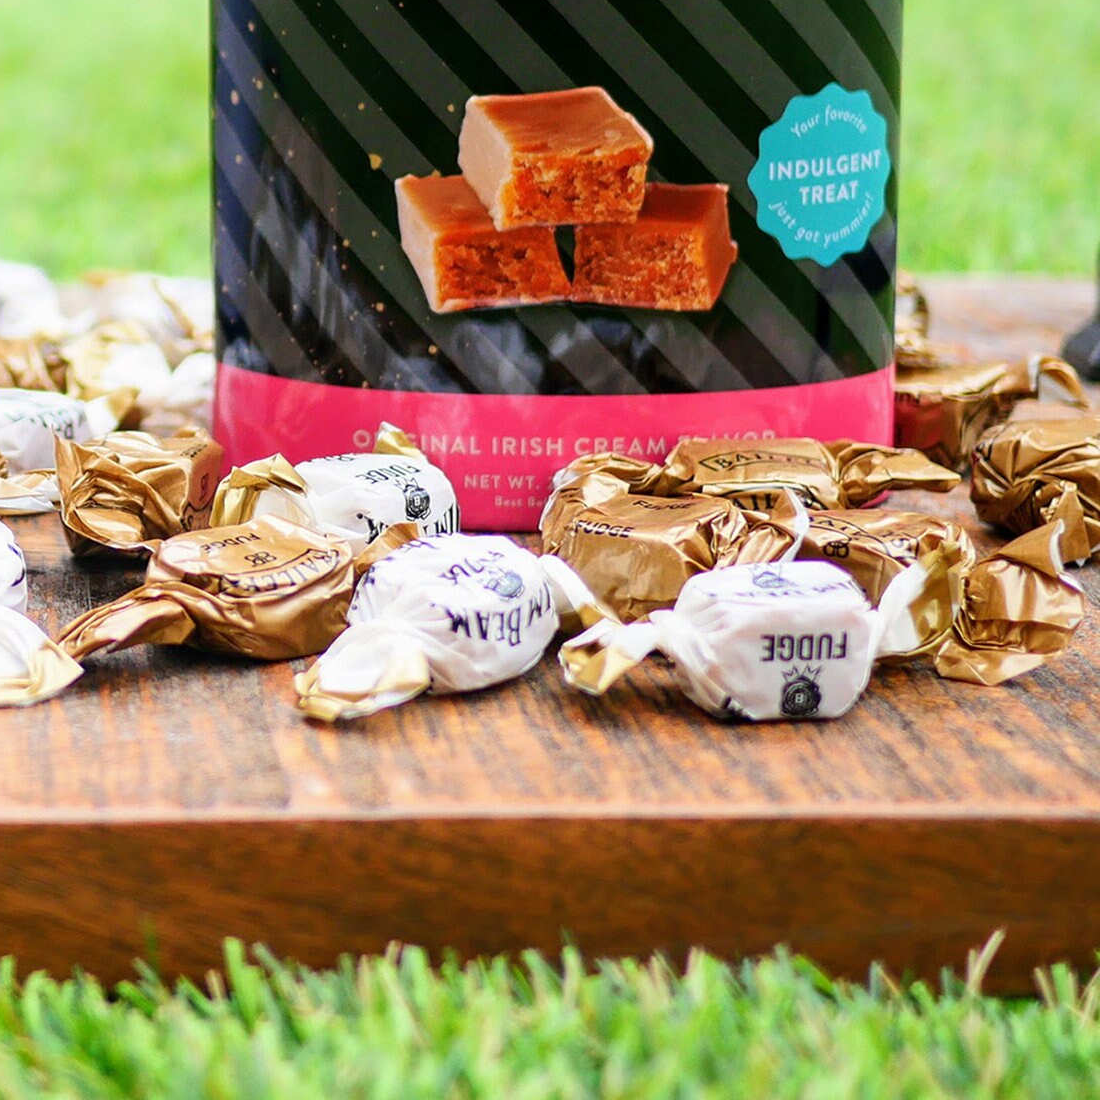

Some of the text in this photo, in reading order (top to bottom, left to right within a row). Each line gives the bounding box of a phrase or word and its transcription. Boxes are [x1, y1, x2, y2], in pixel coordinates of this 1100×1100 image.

[790, 103, 868, 138] Your favorite
[768, 149, 882, 181] INDULGENT
[799, 180, 859, 206] TREAT
[768, 200, 797, 230] just
[794, 228, 821, 244] got
[492, 436, 564, 457] IRISH
[574, 436, 666, 457] CREAM
[464, 474, 500, 489] NET
[574, 519, 635, 539] FUDGE
[759, 631, 848, 662] FUDGE
